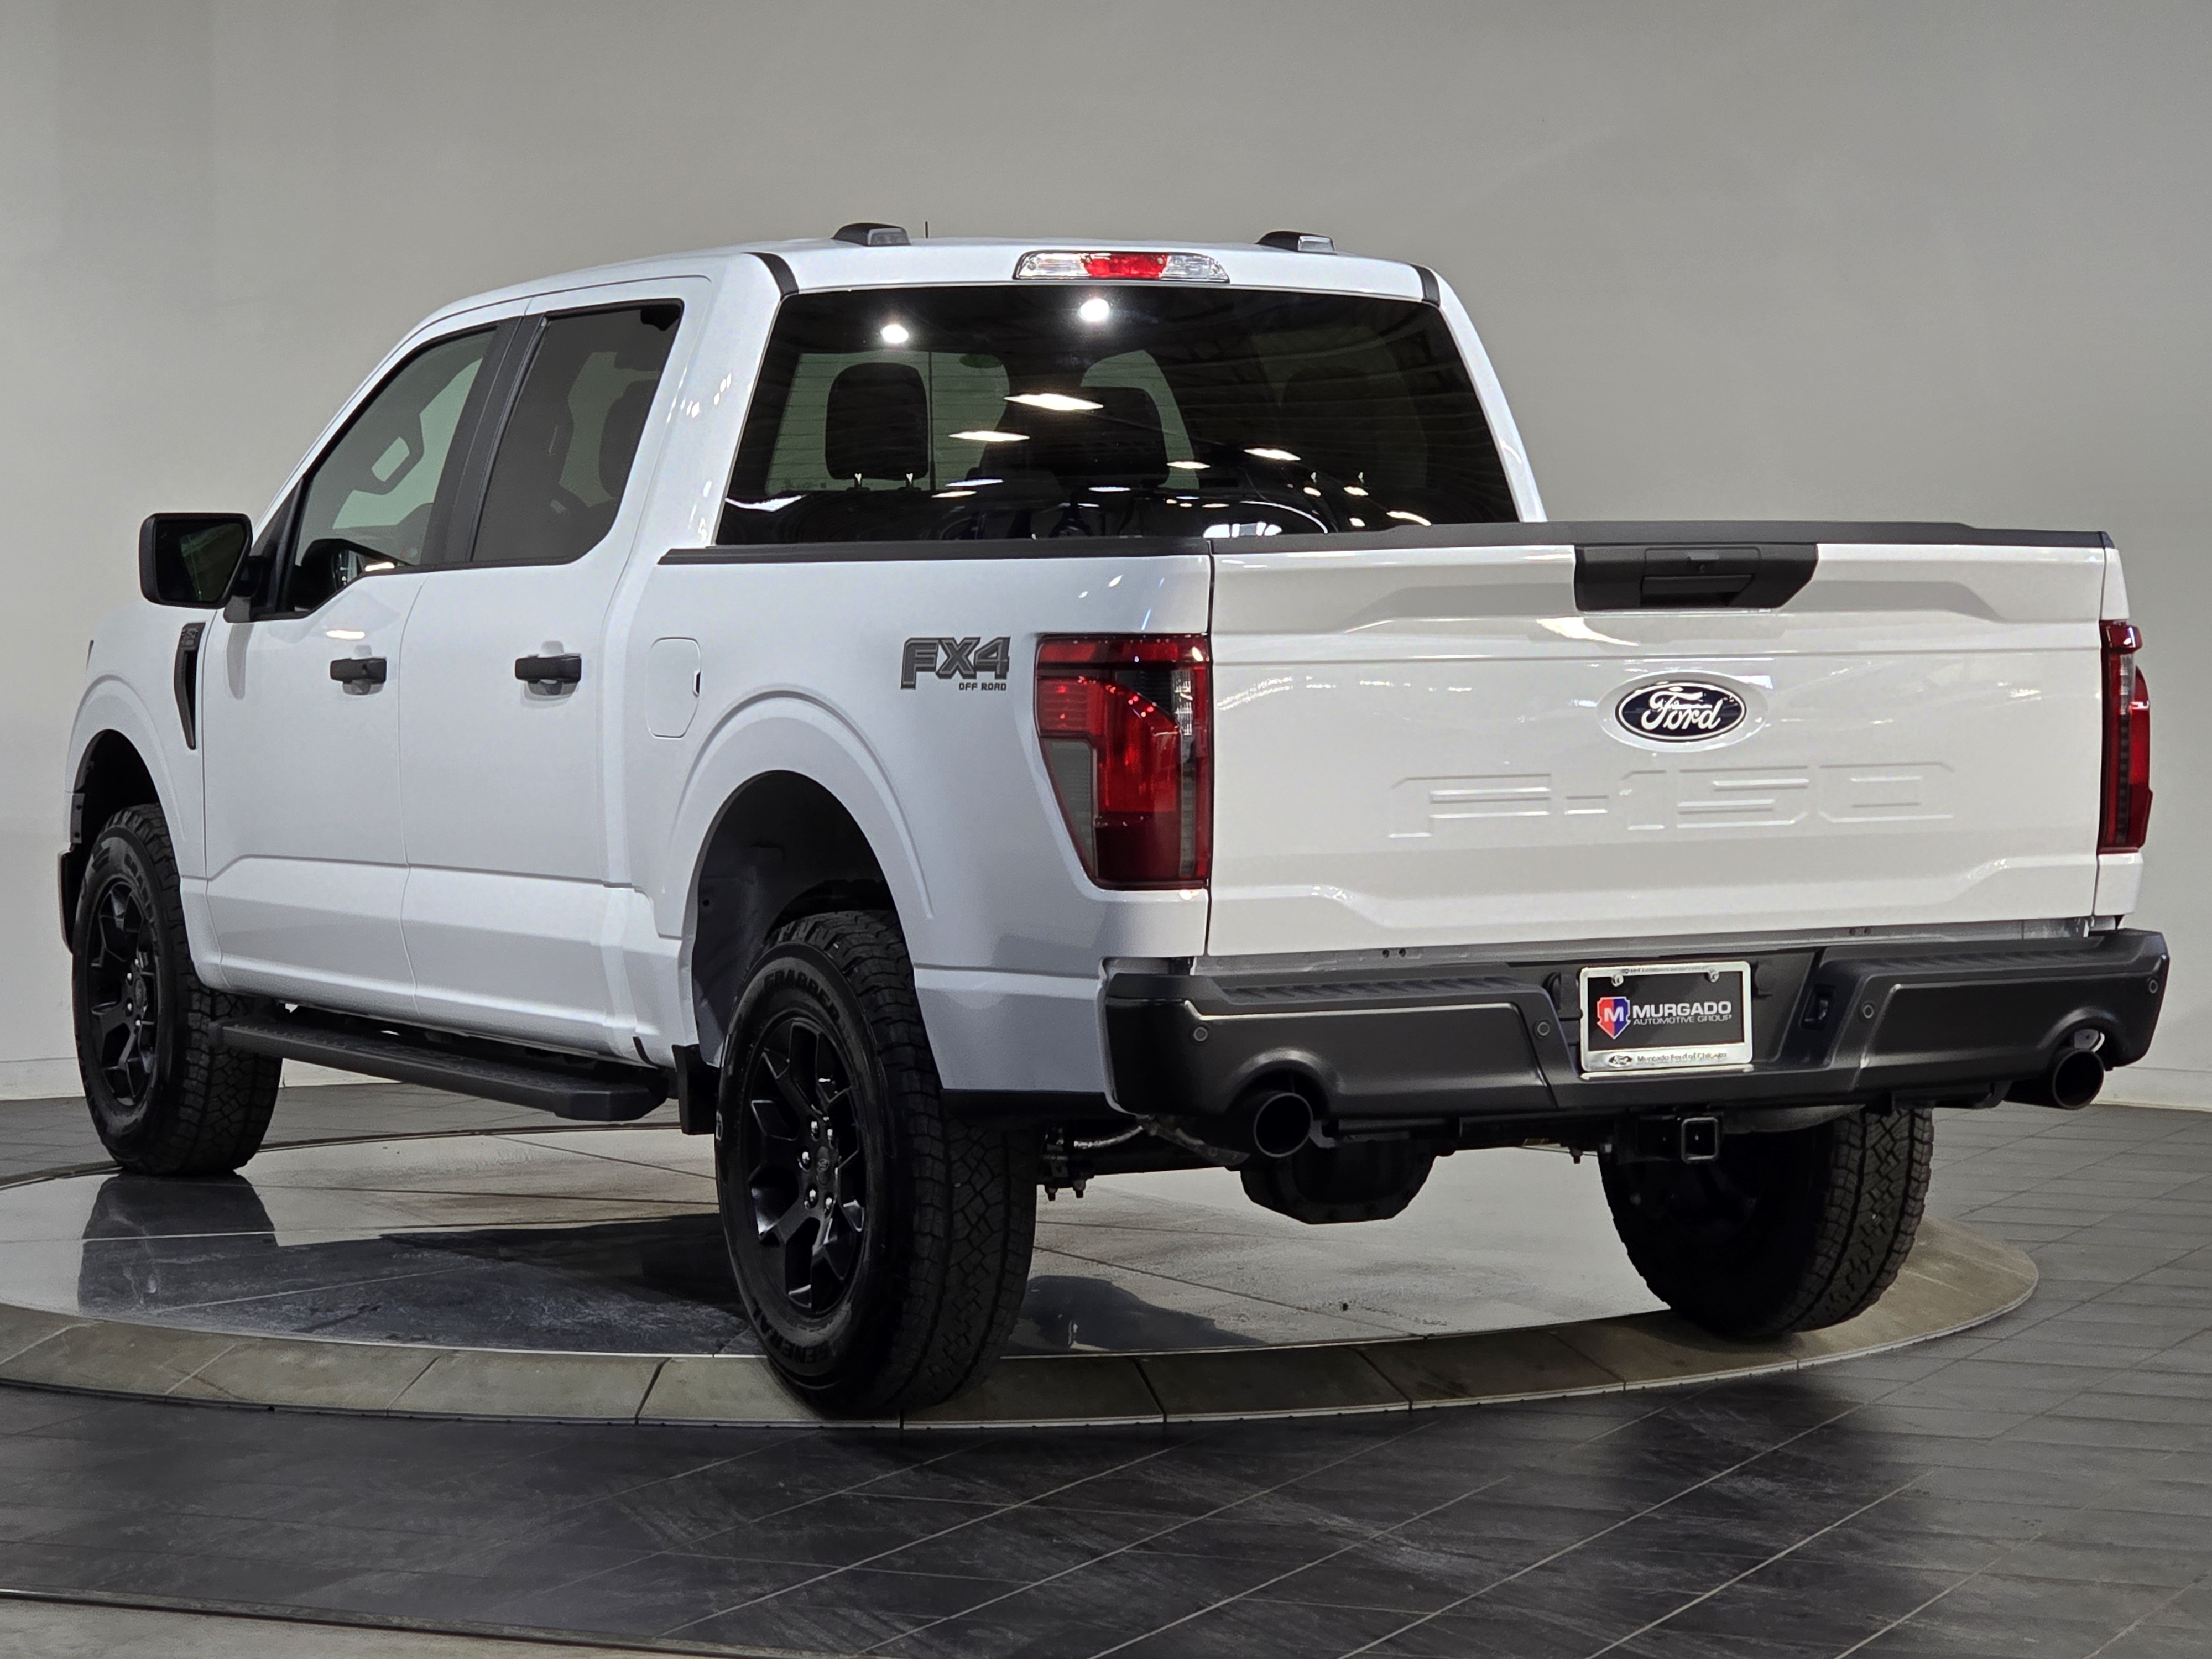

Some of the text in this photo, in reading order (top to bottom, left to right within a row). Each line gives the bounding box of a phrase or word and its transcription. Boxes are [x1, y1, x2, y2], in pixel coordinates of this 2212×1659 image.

[901, 637, 1011, 690] FX4
[959, 682, 1006, 691] OFF ROAD
[1641, 691, 1724, 730] Ford
[1388, 761, 1954, 838] F-150
[1604, 1006, 1624, 1022] M
[1632, 1001, 1732, 1018] MURGADO
[1634, 1014, 1733, 1025] AUTOMOTIVE GROUP
